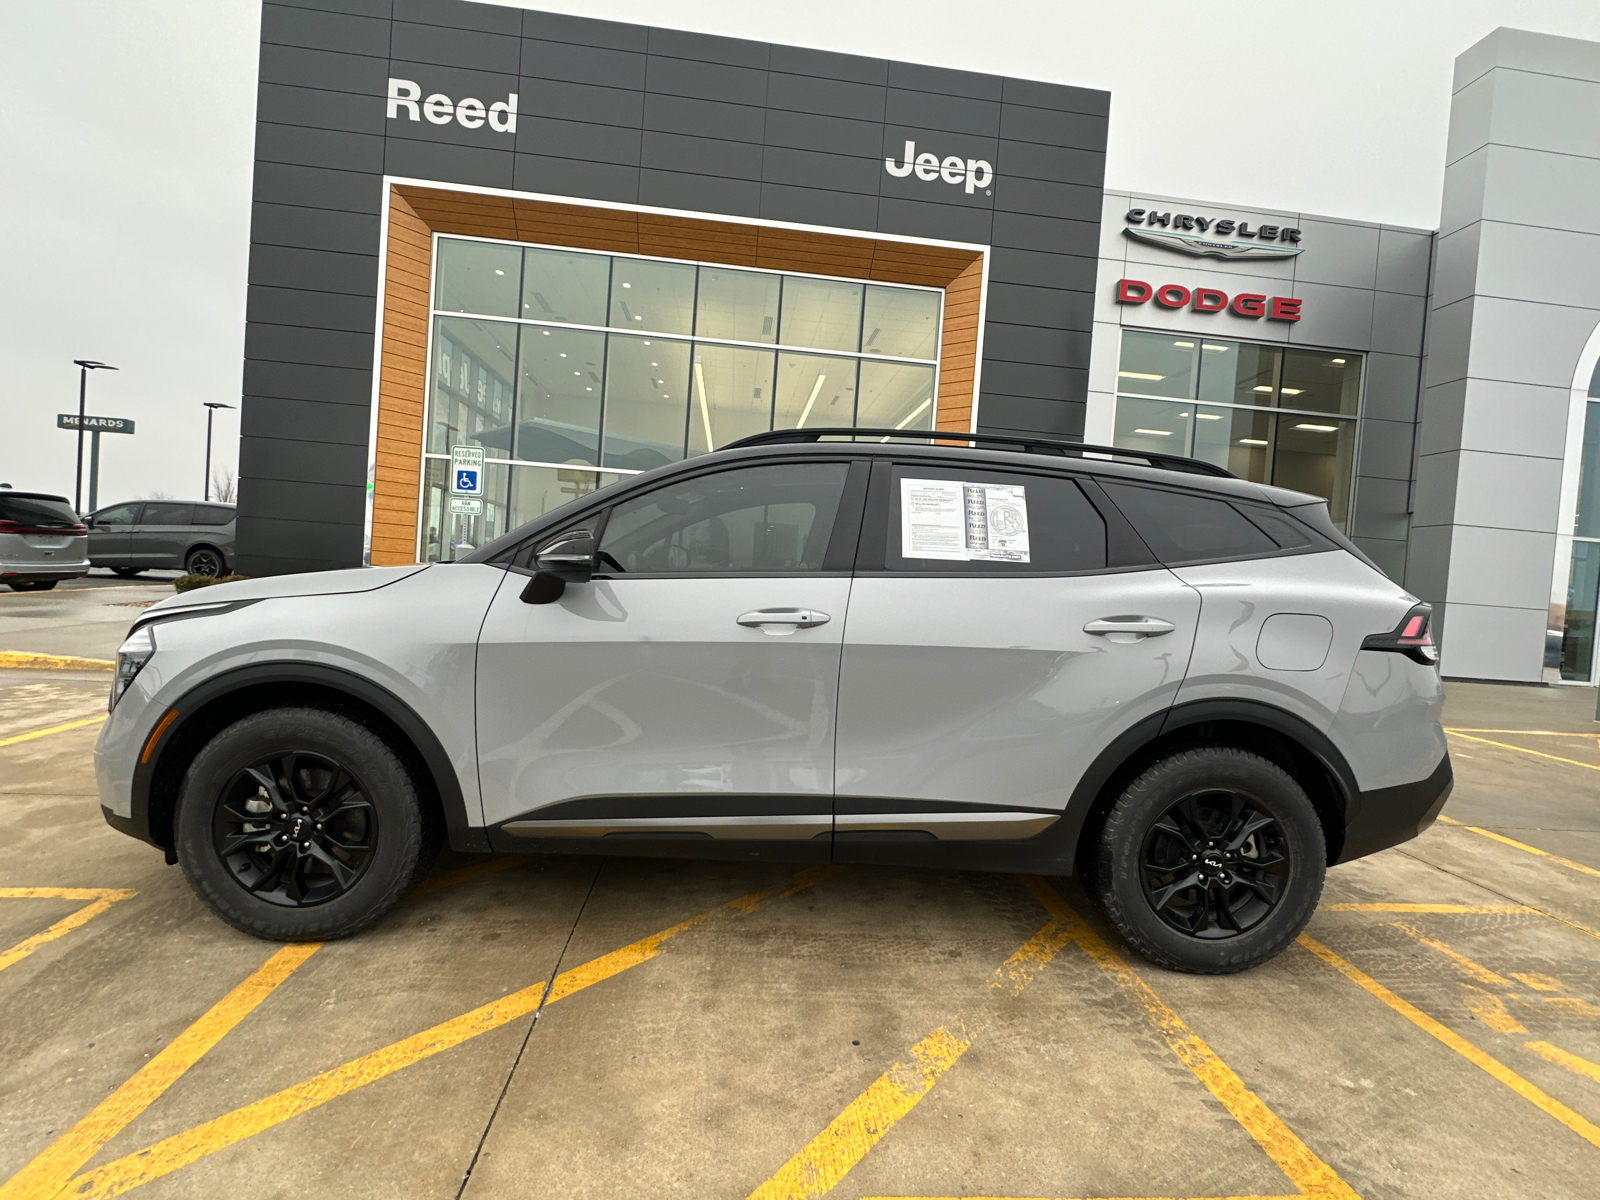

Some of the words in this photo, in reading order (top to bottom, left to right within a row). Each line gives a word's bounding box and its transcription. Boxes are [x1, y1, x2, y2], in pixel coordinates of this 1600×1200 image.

[386, 77, 519, 134] Reed
[885, 140, 993, 195] Jeep
[1126, 208, 1302, 243] CHRYSLER
[1116, 278, 1303, 322] DODGE
[454, 450, 482, 459] RESERVED
[454, 458, 482, 467] PARKING
